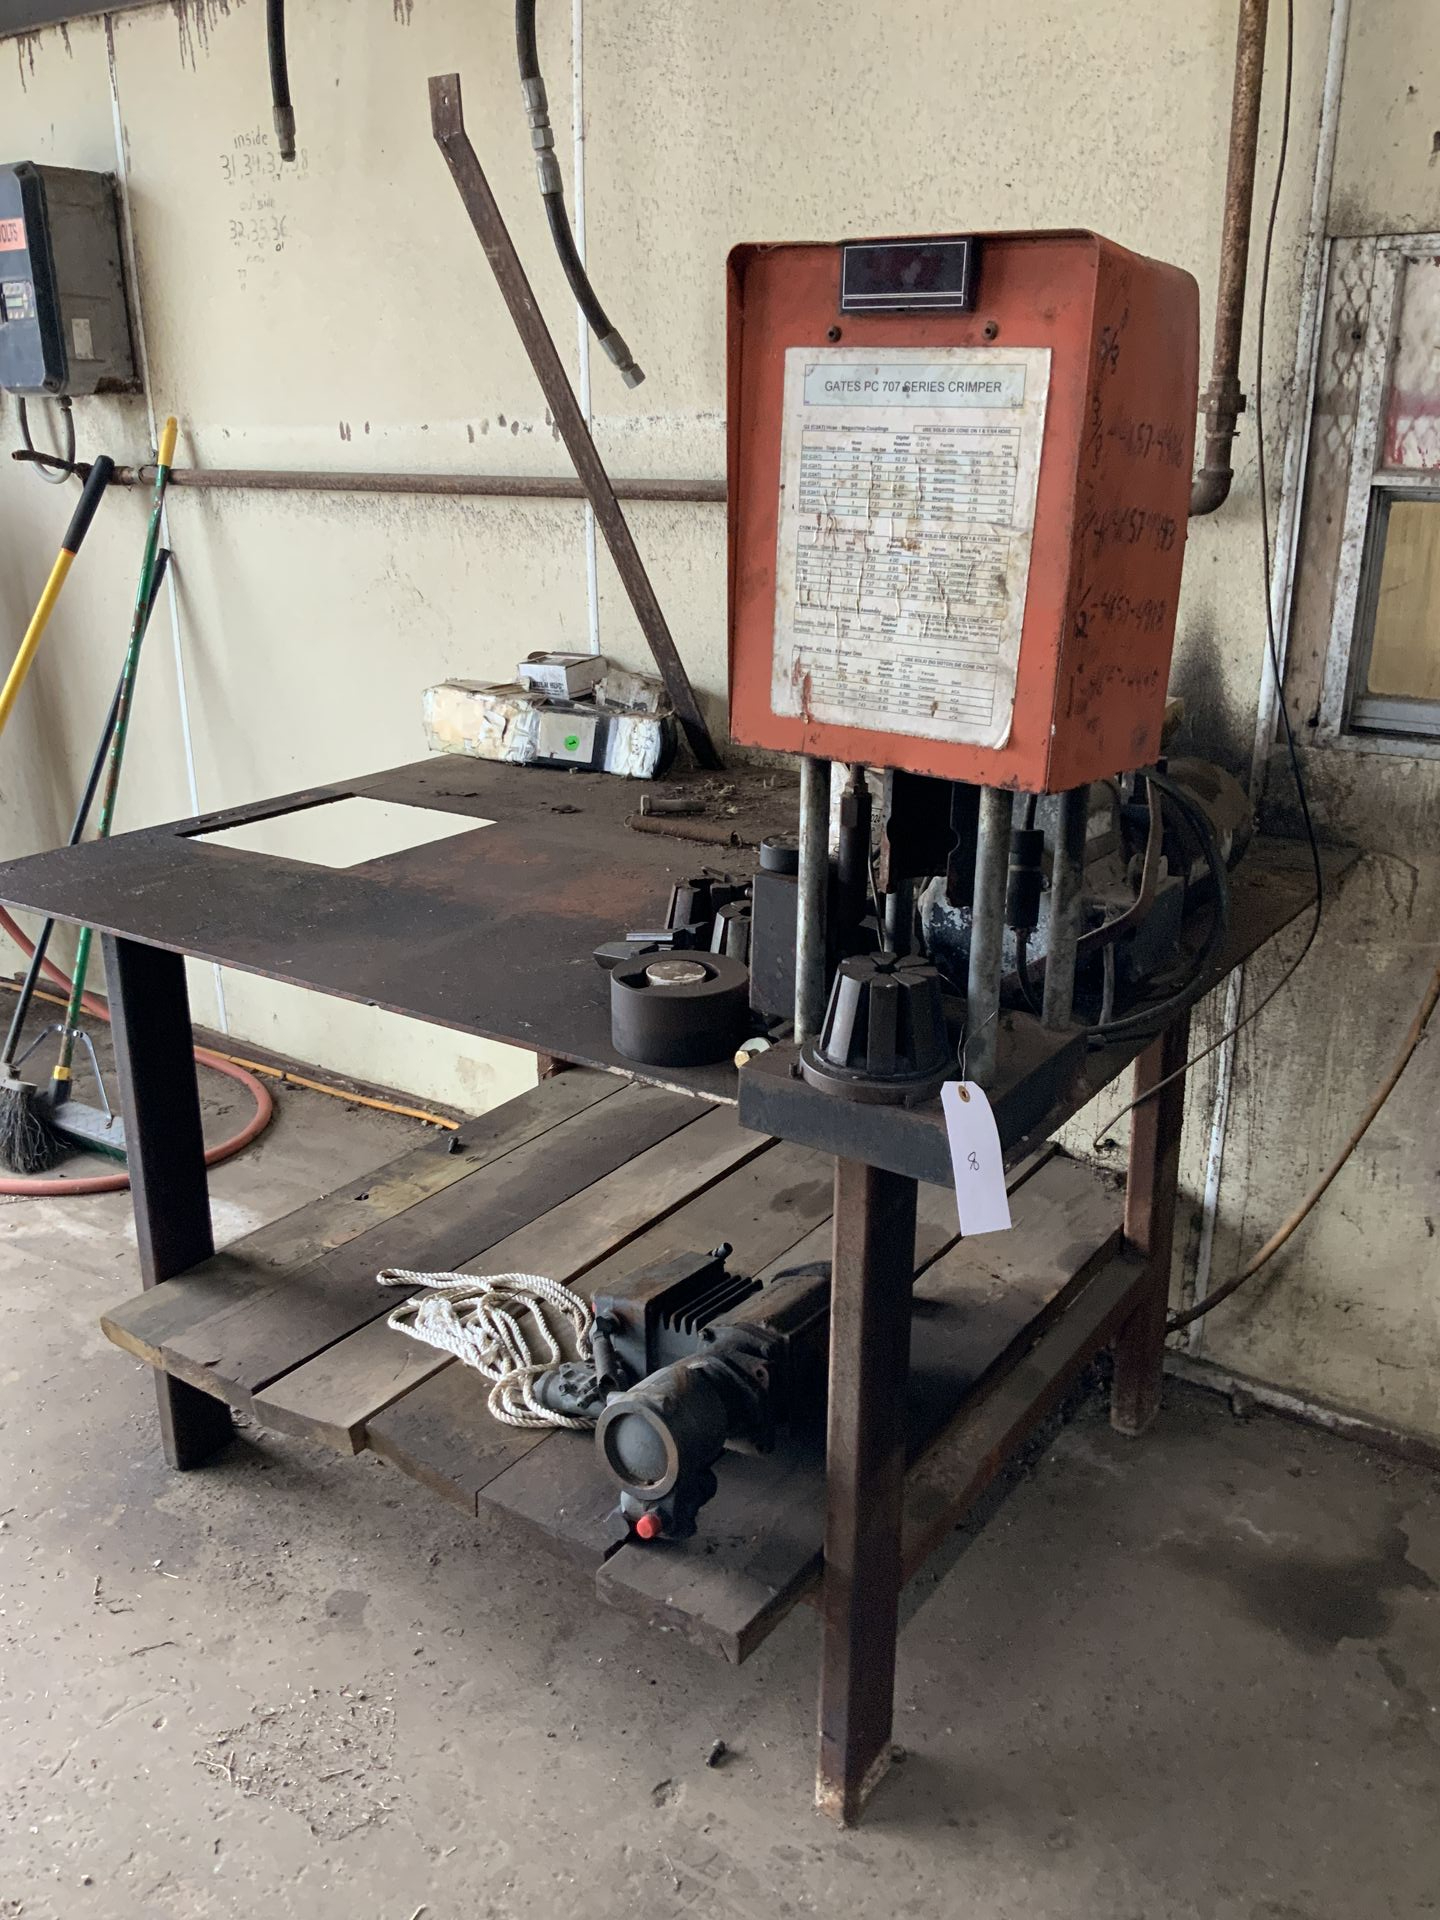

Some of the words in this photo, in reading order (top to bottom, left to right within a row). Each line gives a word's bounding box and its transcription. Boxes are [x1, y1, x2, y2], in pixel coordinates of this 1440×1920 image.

[234, 124, 268, 149] inside
[0, 223, 18, 243] OLTS
[824, 380, 861, 392] GATES
[864, 380, 879, 392] PC
[882, 380, 900, 392] 707
[903, 380, 945, 393] SERIES
[947, 380, 1002, 393] CRIMPER
[967, 1151, 980, 1171] 8
